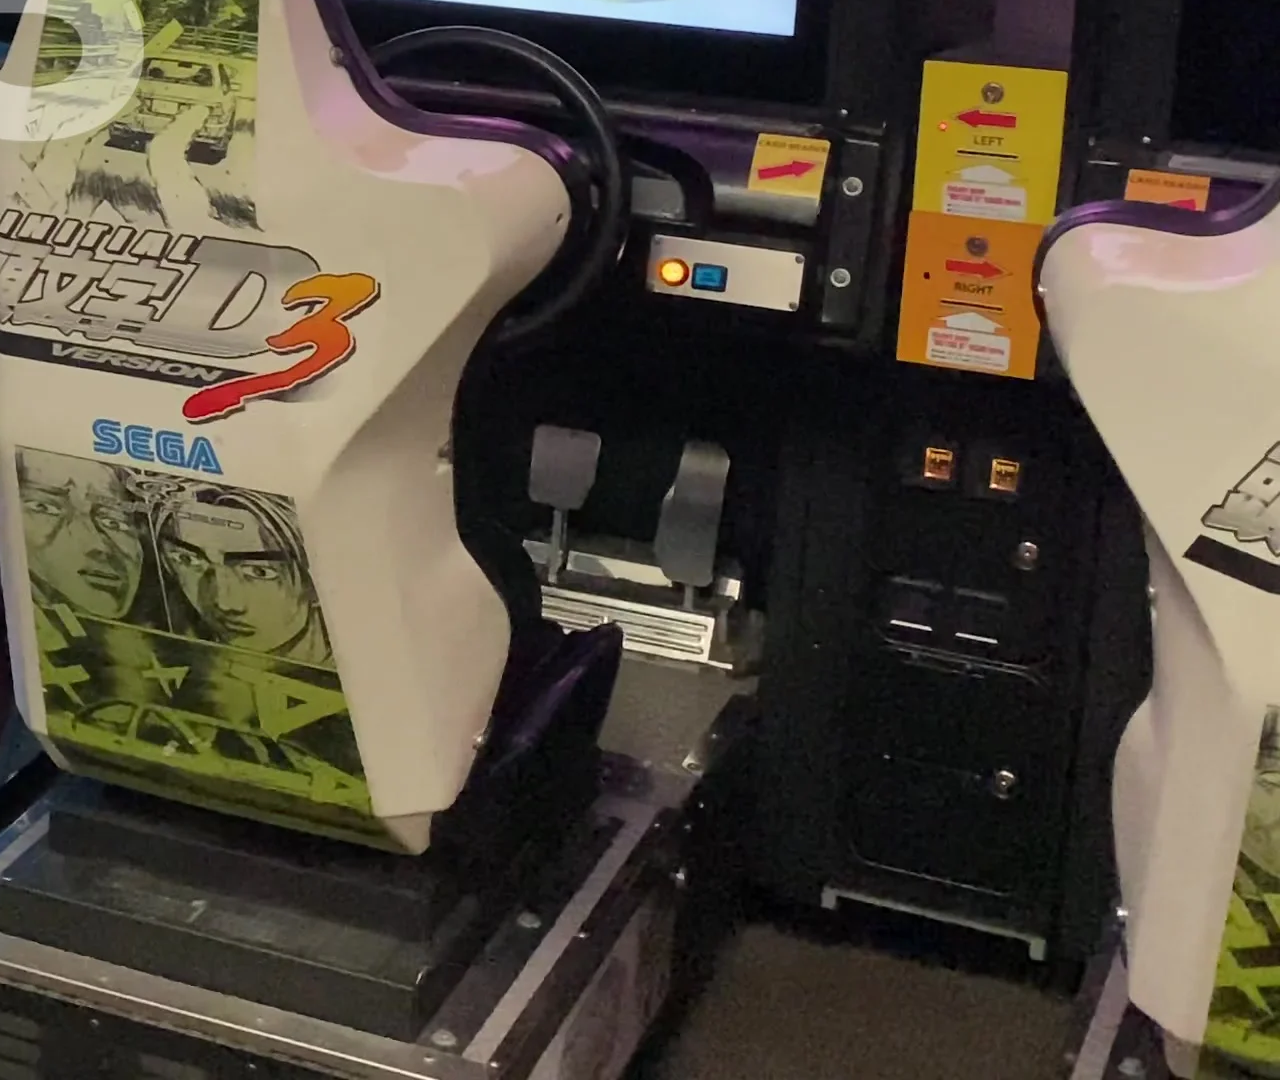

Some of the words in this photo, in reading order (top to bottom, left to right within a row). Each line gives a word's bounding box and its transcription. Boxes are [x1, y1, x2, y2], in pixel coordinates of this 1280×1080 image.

[972, 135, 1005, 147] LEFT
[954, 281, 994, 296] RIGHT
[51, 342, 224, 383] VERSION
[182, 273, 380, 424] 3
[92, 418, 223, 475] SEGA
